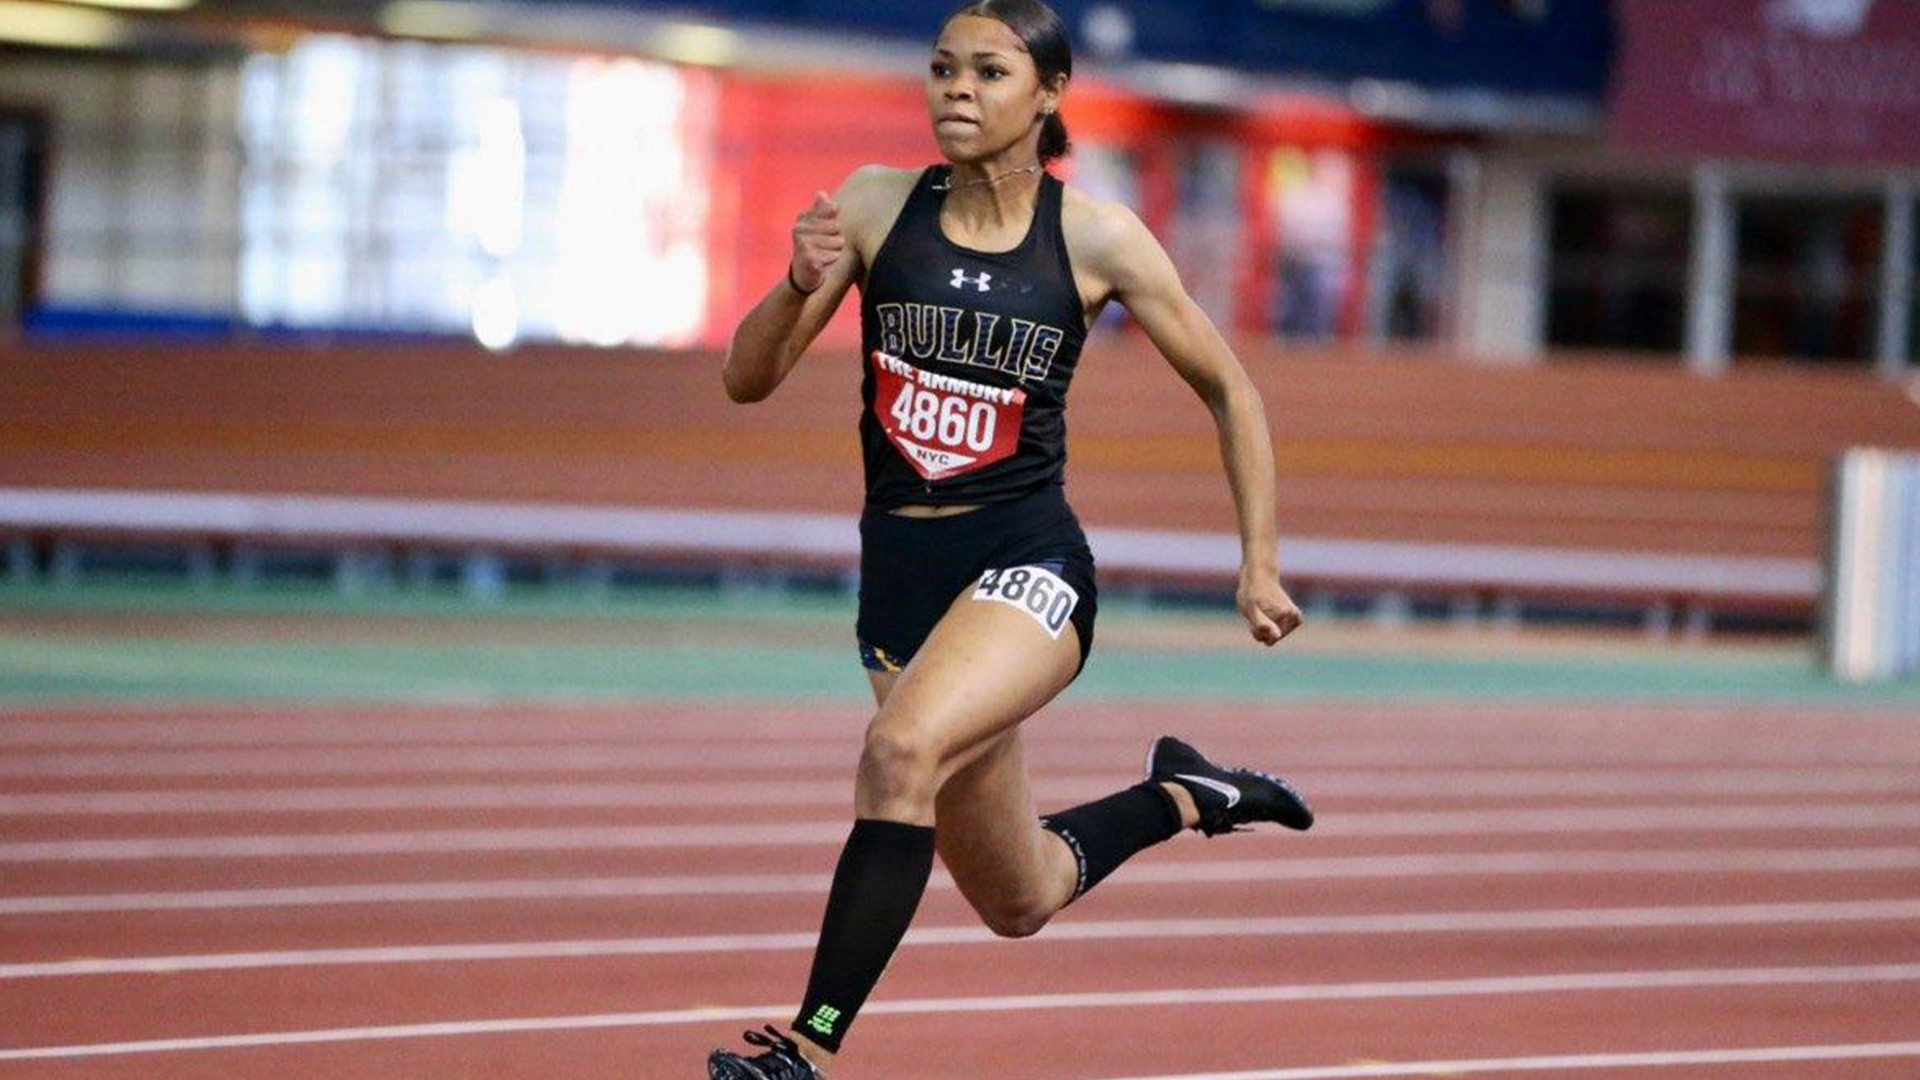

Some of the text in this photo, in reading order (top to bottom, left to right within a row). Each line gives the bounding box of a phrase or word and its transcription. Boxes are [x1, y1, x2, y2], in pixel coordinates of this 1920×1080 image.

[877, 303, 1064, 381] BULLIS
[876, 352, 1015, 405] THE ARMORY
[891, 382, 998, 452] 4860
[916, 449, 950, 466] NYC
[979, 568, 1073, 632] 4860
